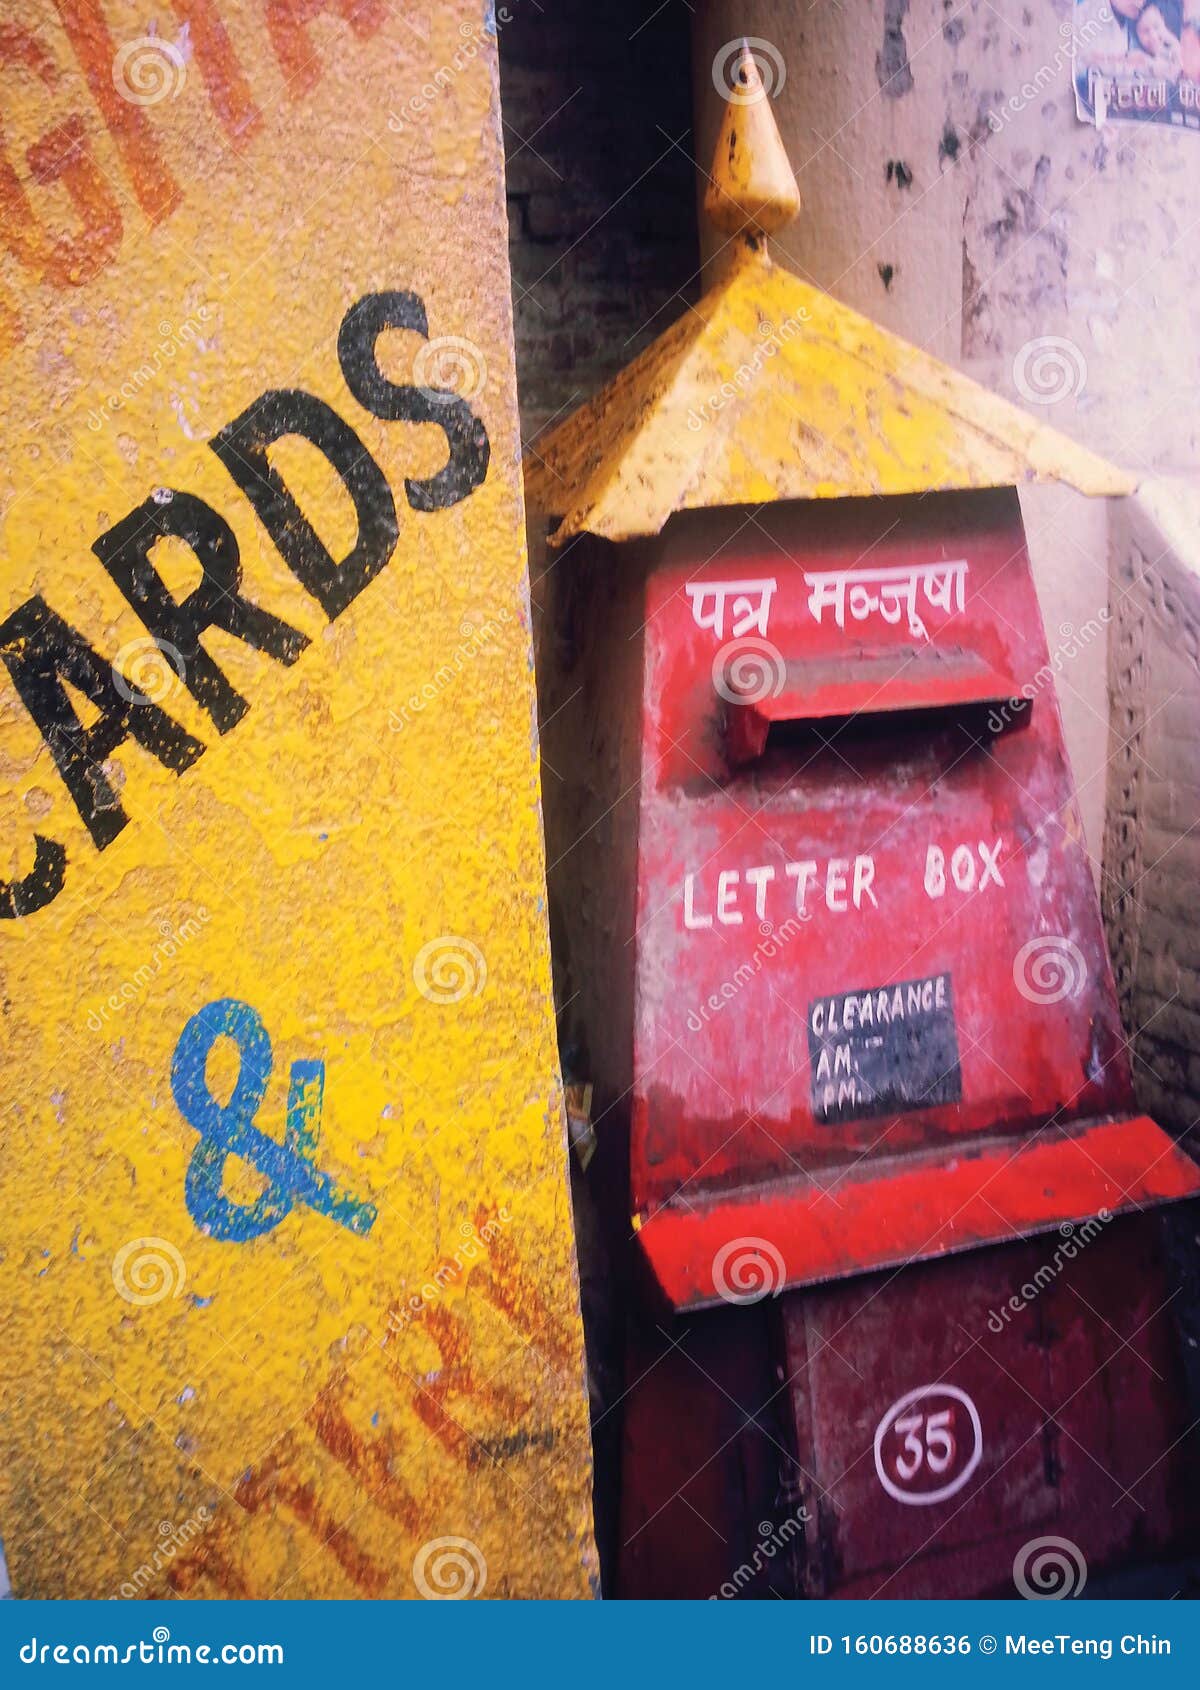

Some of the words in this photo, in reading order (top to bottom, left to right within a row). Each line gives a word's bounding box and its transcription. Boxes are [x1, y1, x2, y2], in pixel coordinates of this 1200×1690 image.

[685, 577, 778, 641] पत्र
[683, 854, 879, 930] LETTER
[923, 838, 1006, 900] BOX
[811, 975, 948, 1037] CLEARANCE
[170, 997, 378, 1244] &
[894, 1409, 953, 1480] 35
